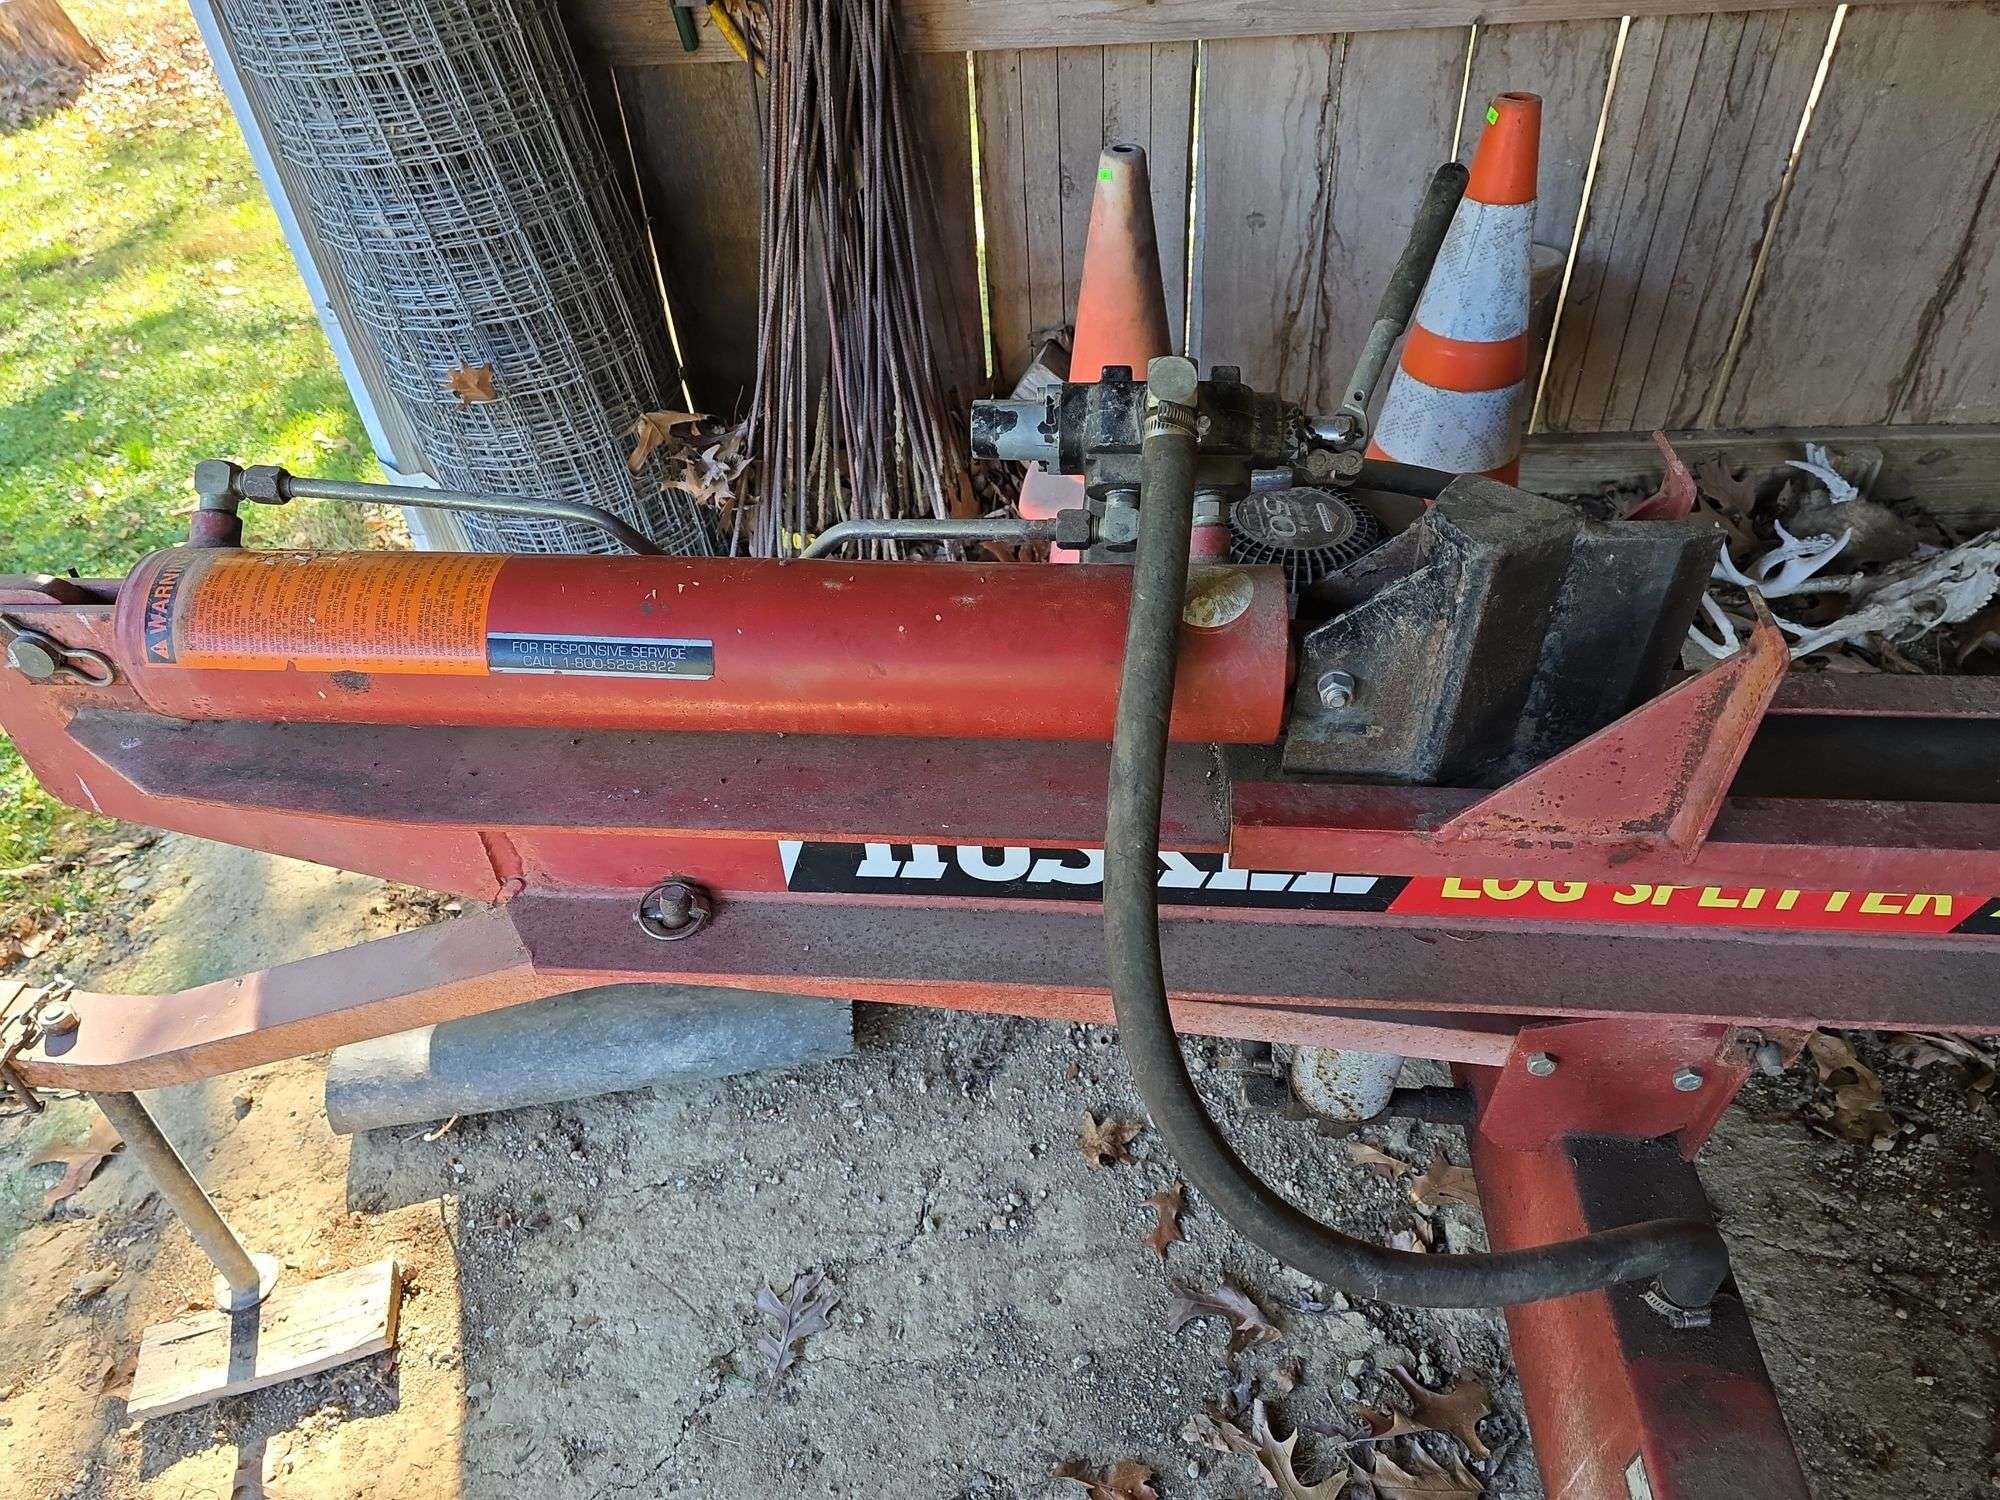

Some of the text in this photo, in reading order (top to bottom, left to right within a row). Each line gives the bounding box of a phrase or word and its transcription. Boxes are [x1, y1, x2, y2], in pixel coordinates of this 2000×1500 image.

[147, 558, 186, 634] WARNI
[512, 640, 686, 660] FOR RESPONSIVE SERVICE
[522, 655, 677, 672] CALL 1-800-525-8322
